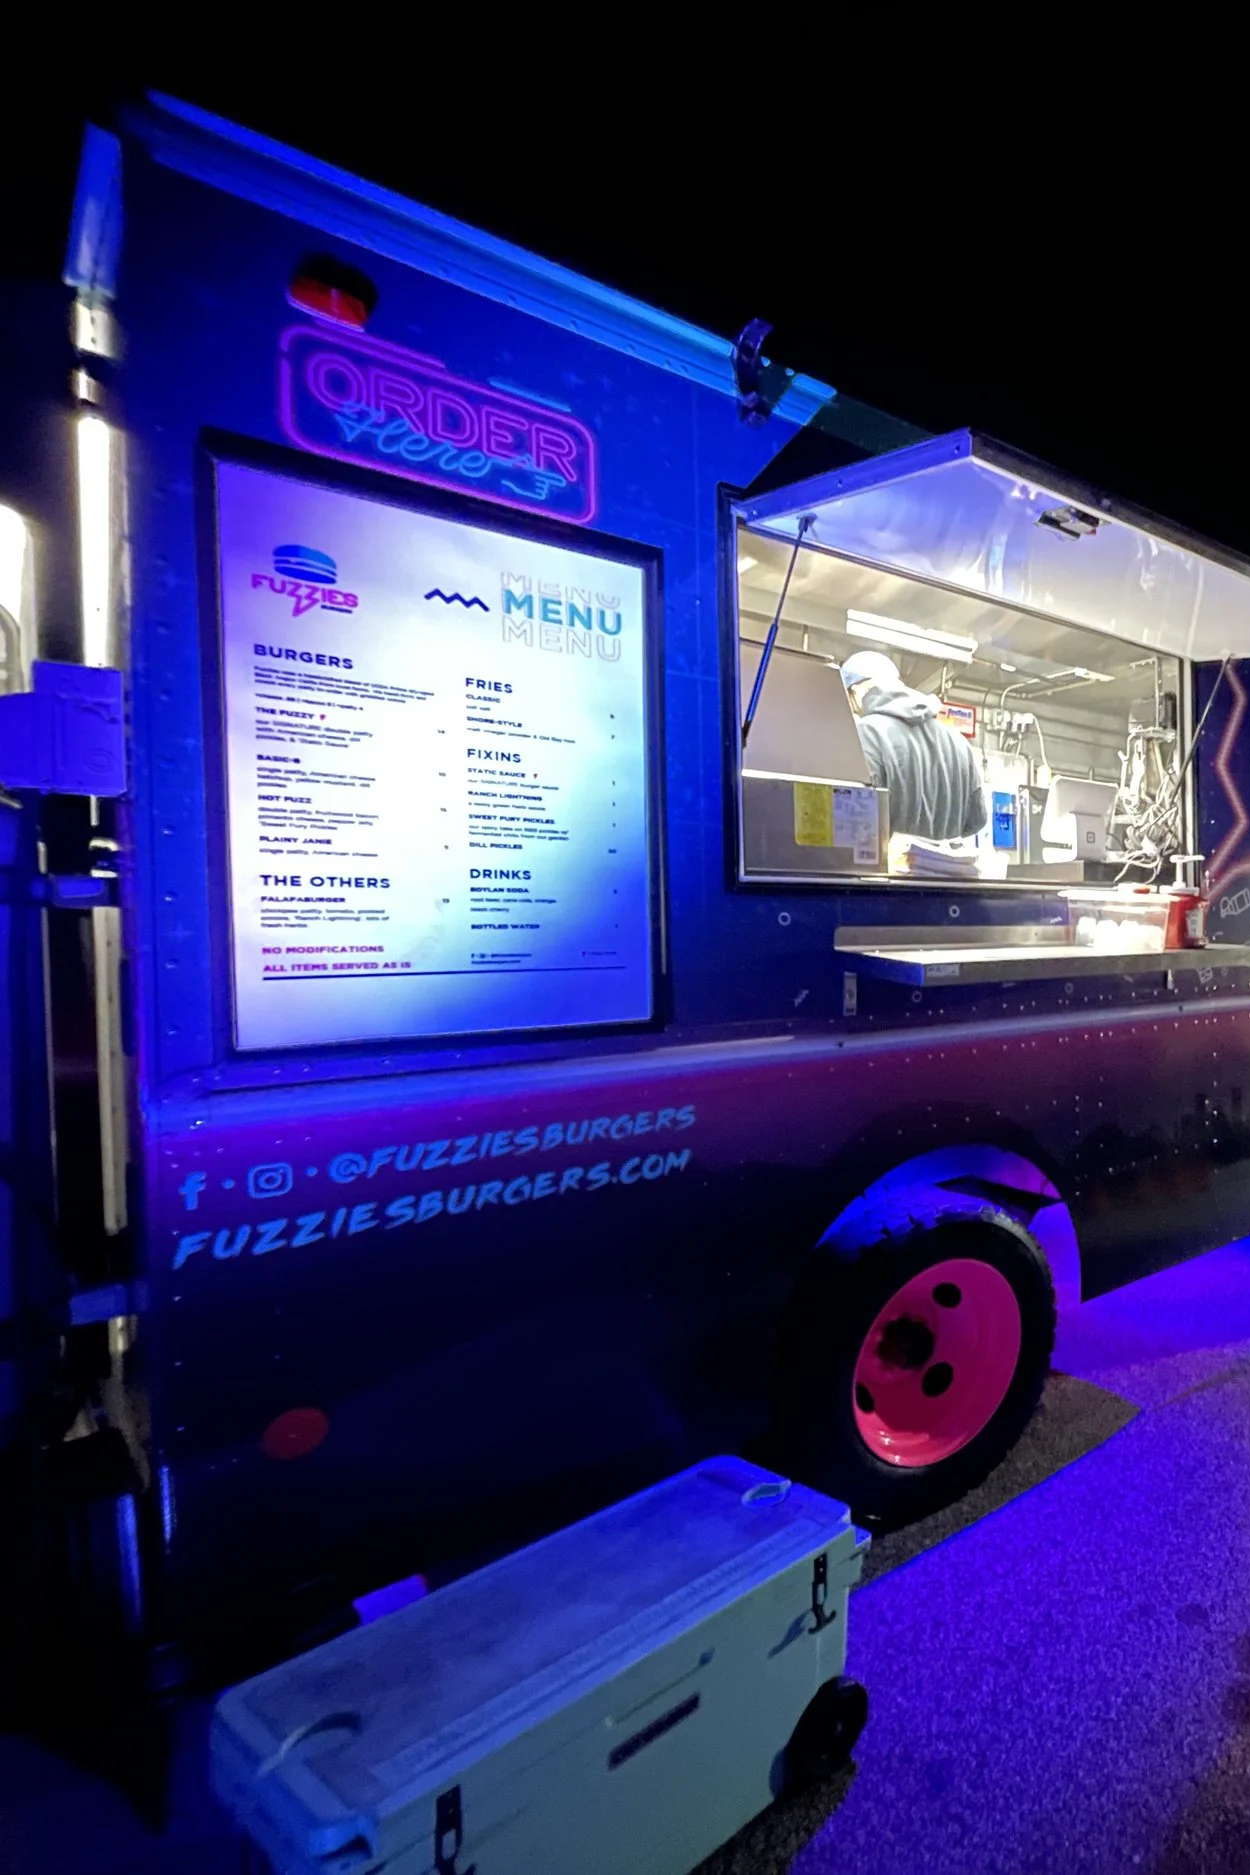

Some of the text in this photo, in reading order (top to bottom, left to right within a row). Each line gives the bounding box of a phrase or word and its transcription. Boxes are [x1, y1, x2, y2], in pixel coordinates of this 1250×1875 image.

[306, 352, 578, 482] ORDER
[334, 400, 498, 478] Here
[251, 573, 359, 617] FUZZIES
[503, 588, 622, 636] MENU
[502, 615, 621, 662] MENU
[254, 644, 353, 670] BURGERS
[465, 678, 513, 693] FRIES
[466, 694, 501, 703] CLASSIC
[255, 706, 315, 720] THE FUZZY
[467, 748, 521, 763] FIXINS
[258, 794, 282, 802] HOT
[259, 874, 391, 889] THE OTHERS
[470, 868, 532, 880] DRINKS
[262, 945, 384, 955] NO MODIFICATIONS
[291, 963, 328, 972] ITEMS
[332, 962, 379, 971] SERVED
[382, 961, 397, 969] AS
[401, 961, 411, 969] IS
[328, 1104, 698, 1184] @FUZZIESBURGERS
[171, 1147, 693, 1270] FUZZIESBURGERS.COM
